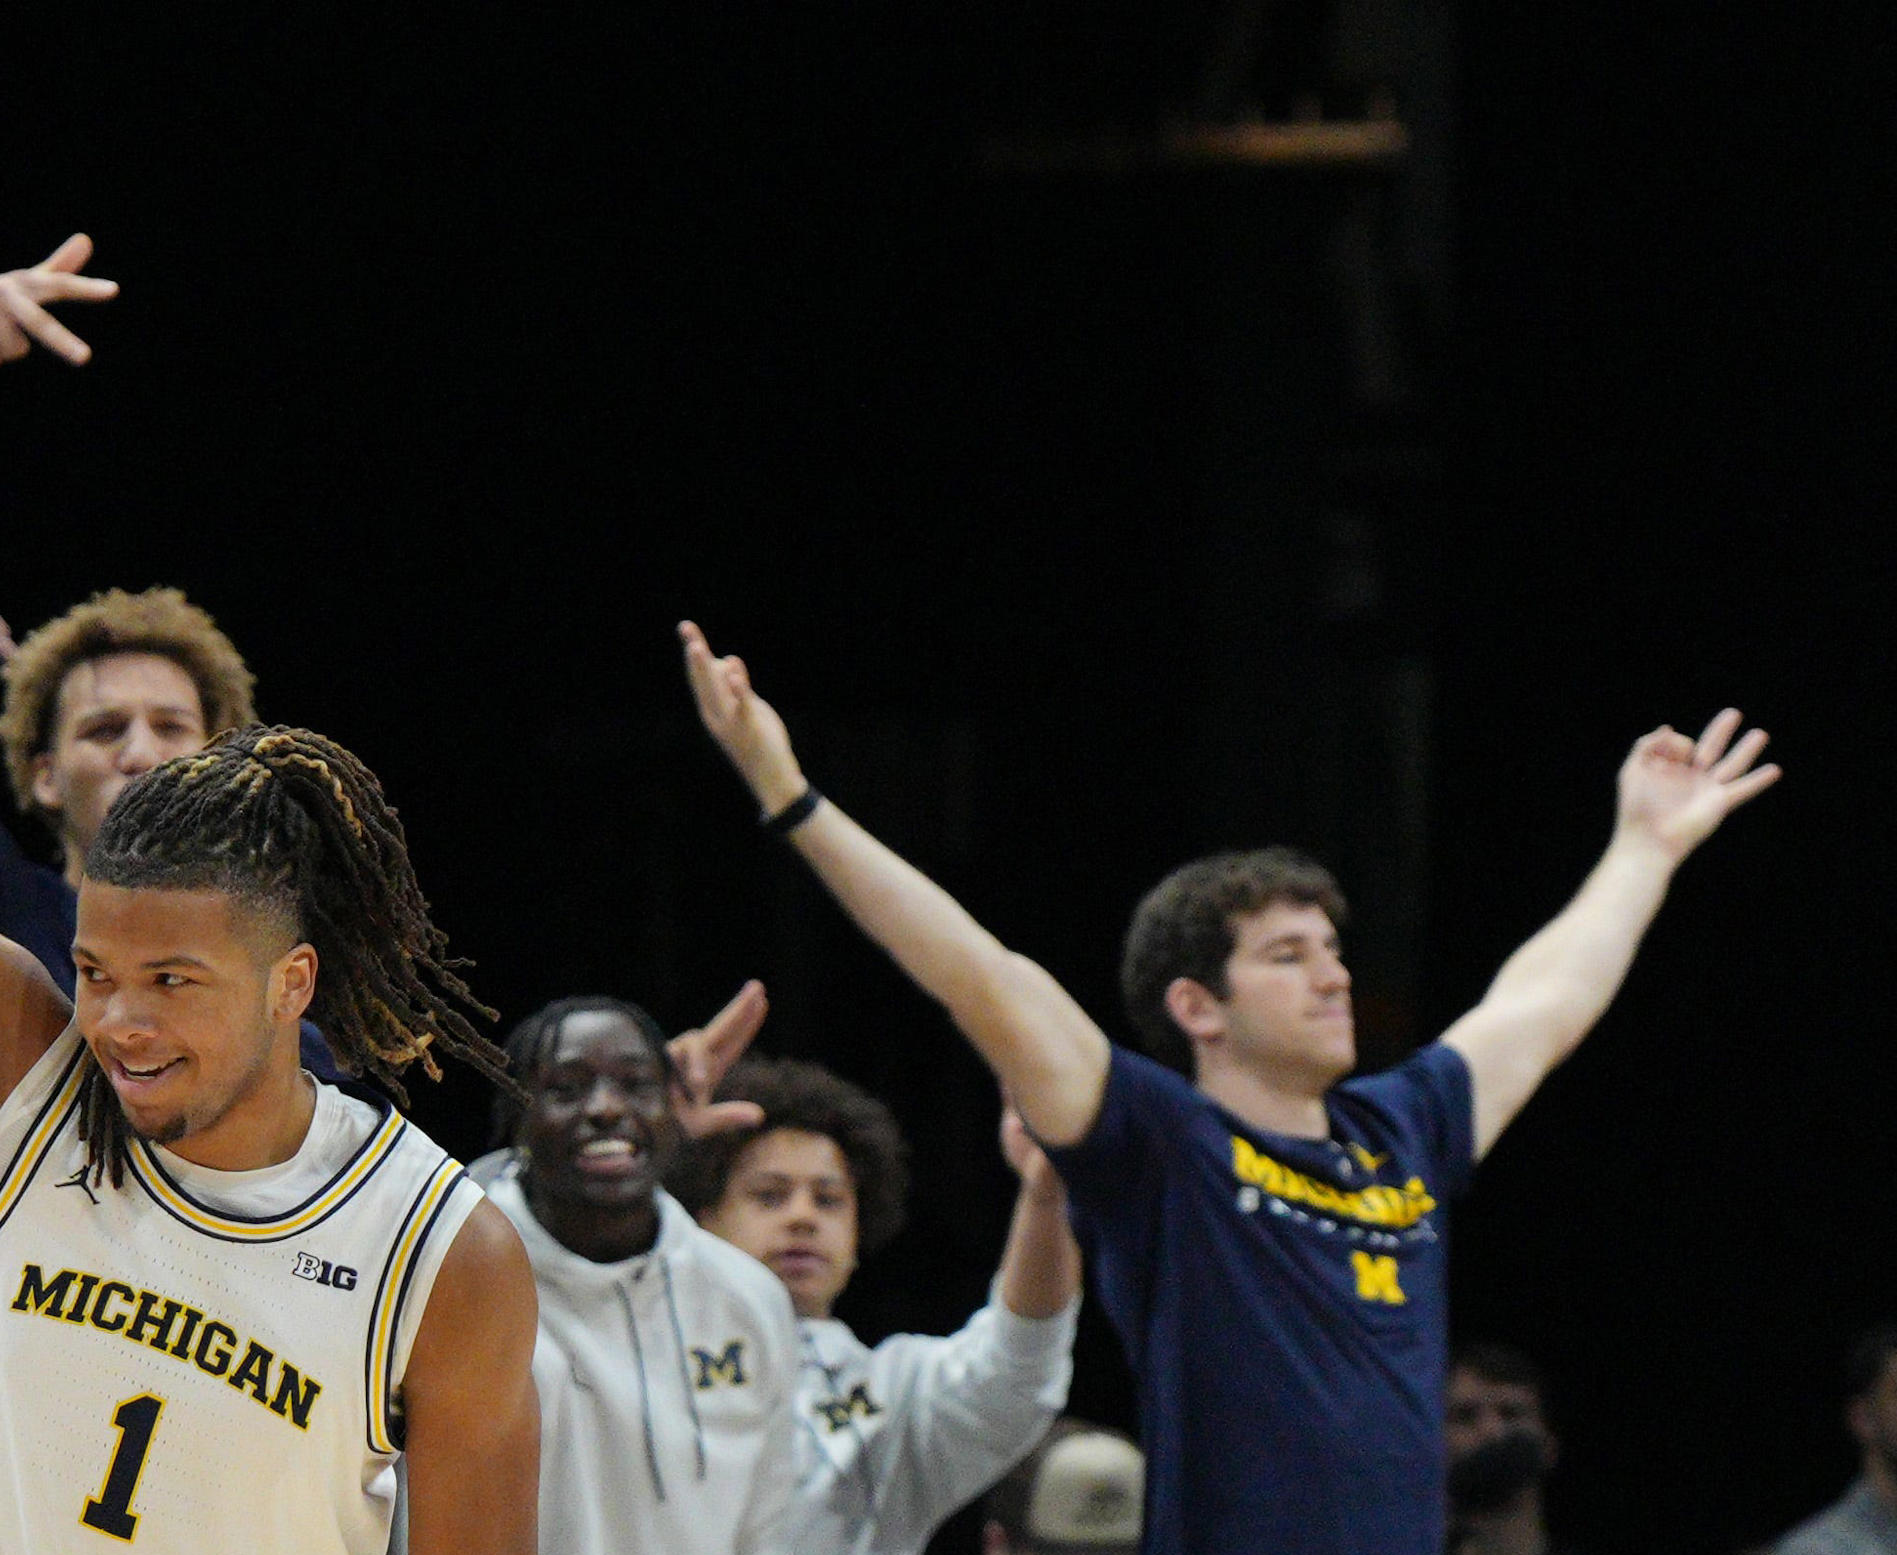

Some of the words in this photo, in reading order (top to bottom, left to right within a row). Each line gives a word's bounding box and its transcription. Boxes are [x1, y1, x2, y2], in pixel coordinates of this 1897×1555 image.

[12, 1265, 321, 1430] MICHIGAN
[692, 1340, 746, 1389] M
[815, 1383, 880, 1431] M
[81, 1393, 166, 1541] 1
